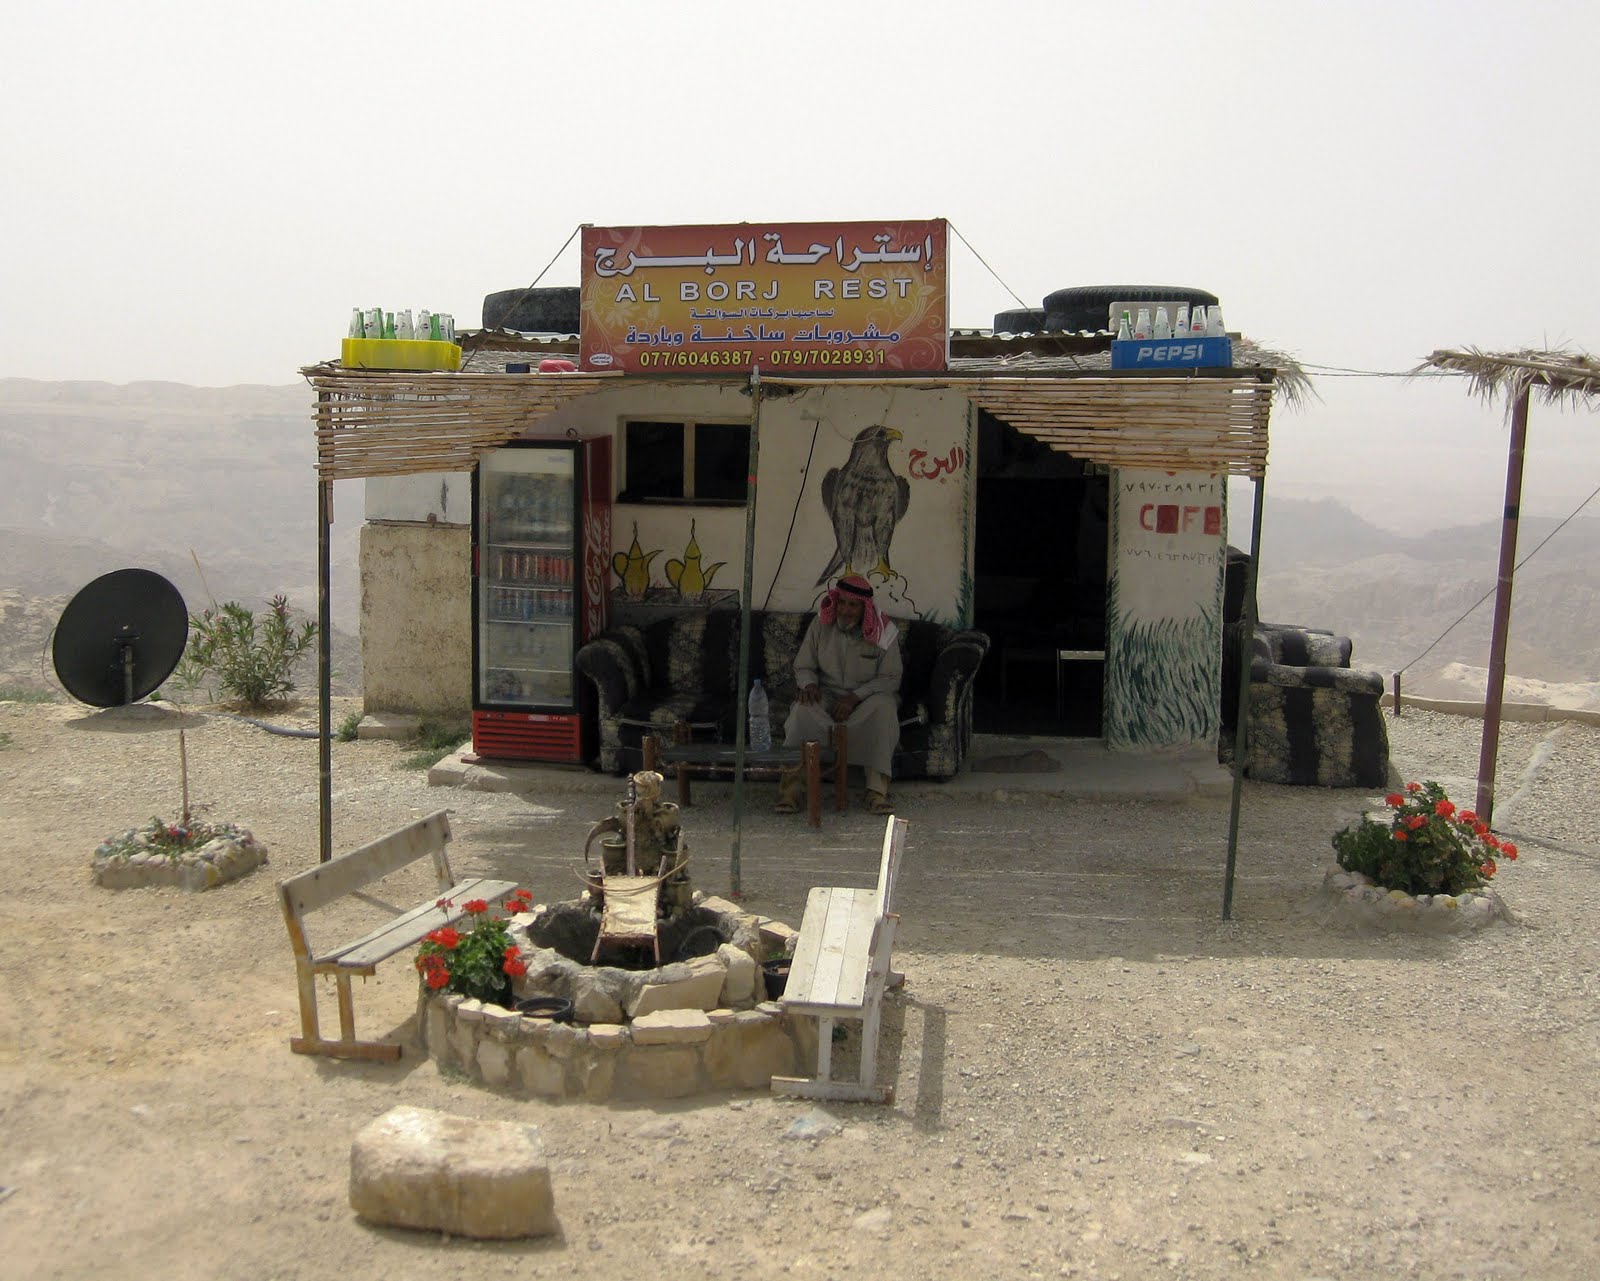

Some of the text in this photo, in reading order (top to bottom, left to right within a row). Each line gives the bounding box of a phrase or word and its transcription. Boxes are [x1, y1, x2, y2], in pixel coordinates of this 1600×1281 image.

[594, 232, 932, 277] إستراحة البرج
[615, 278, 913, 302] AL BORJ REST
[625, 322, 900, 346] مشروبات ساخنة وباردة
[640, 350, 752, 366] 077/6046387
[771, 349, 885, 365] 079/7028931
[1136, 344, 1204, 362] PEPSI
[908, 447, 964, 484] البرج
